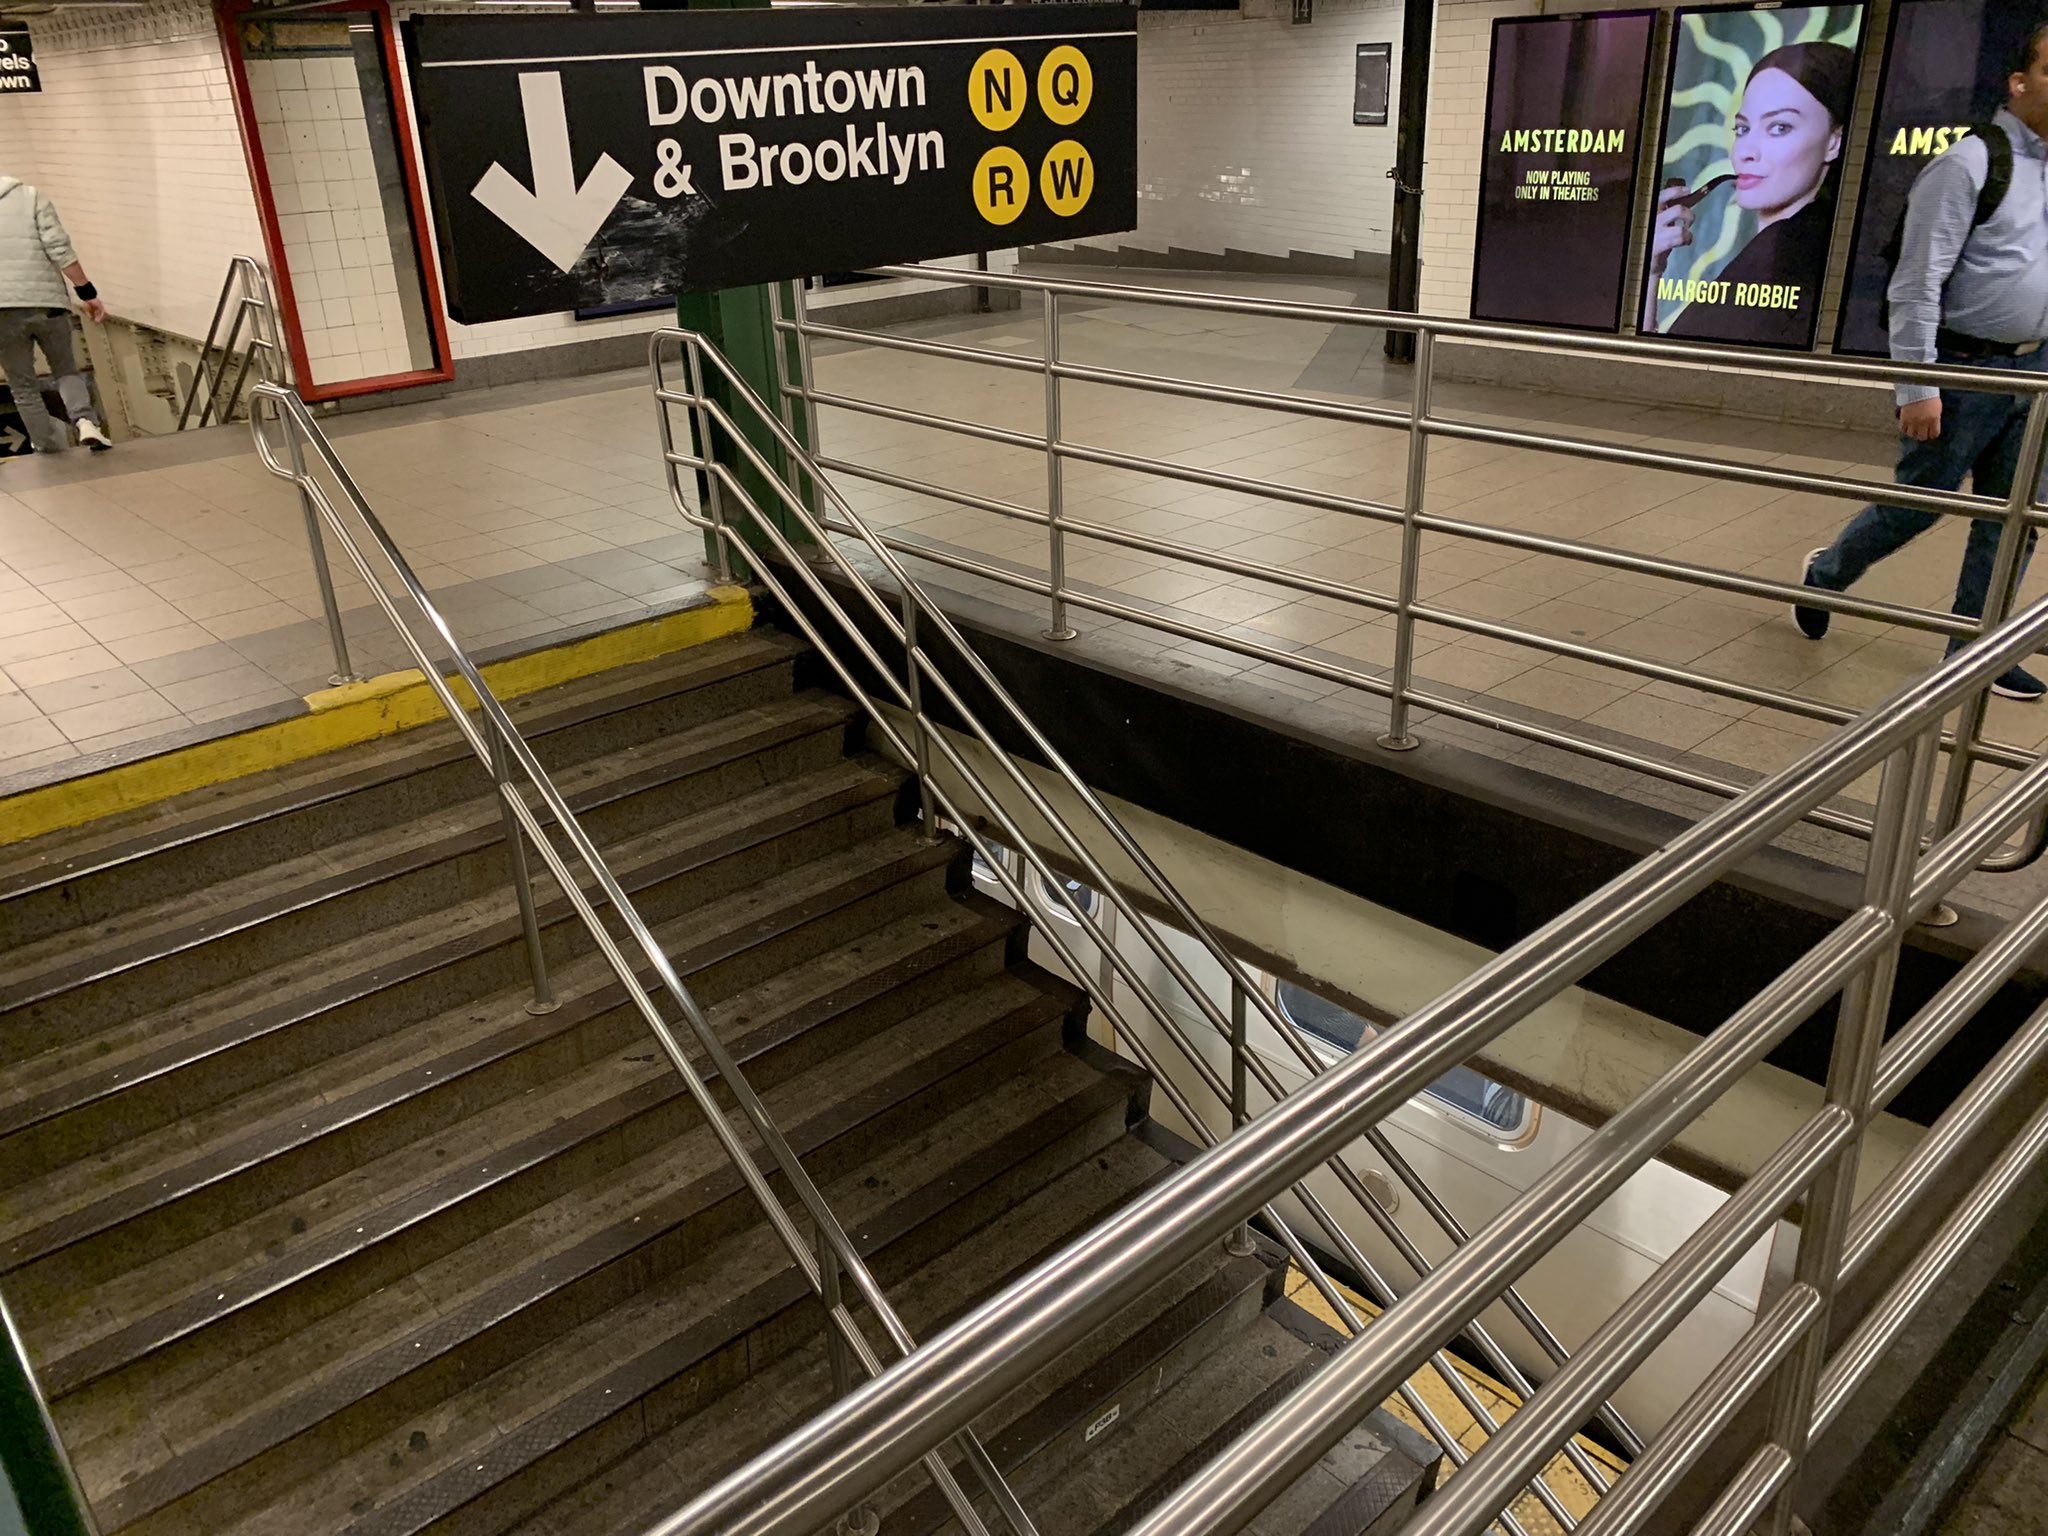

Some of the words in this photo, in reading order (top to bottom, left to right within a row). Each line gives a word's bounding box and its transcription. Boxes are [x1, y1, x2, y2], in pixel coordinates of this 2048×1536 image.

[643, 60, 926, 126] Downtown
[984, 67, 1012, 113] N
[1052, 63, 1079, 107] Q
[653, 138, 697, 199] &
[718, 121, 945, 191] Brooklyn
[1500, 129, 1625, 153] AMSTERDAM
[989, 165, 1014, 208] R
[1050, 157, 1084, 200] W
[1515, 185, 1538, 200] ONLY
[1540, 186, 1550, 200] IN
[1553, 186, 1599, 201] THEATERS
[1526, 170, 1549, 185] NOW
[1551, 171, 1590, 186] PLAYING
[1657, 277, 1731, 305] MARGOT
[1734, 282, 1801, 310] ROBBIE
